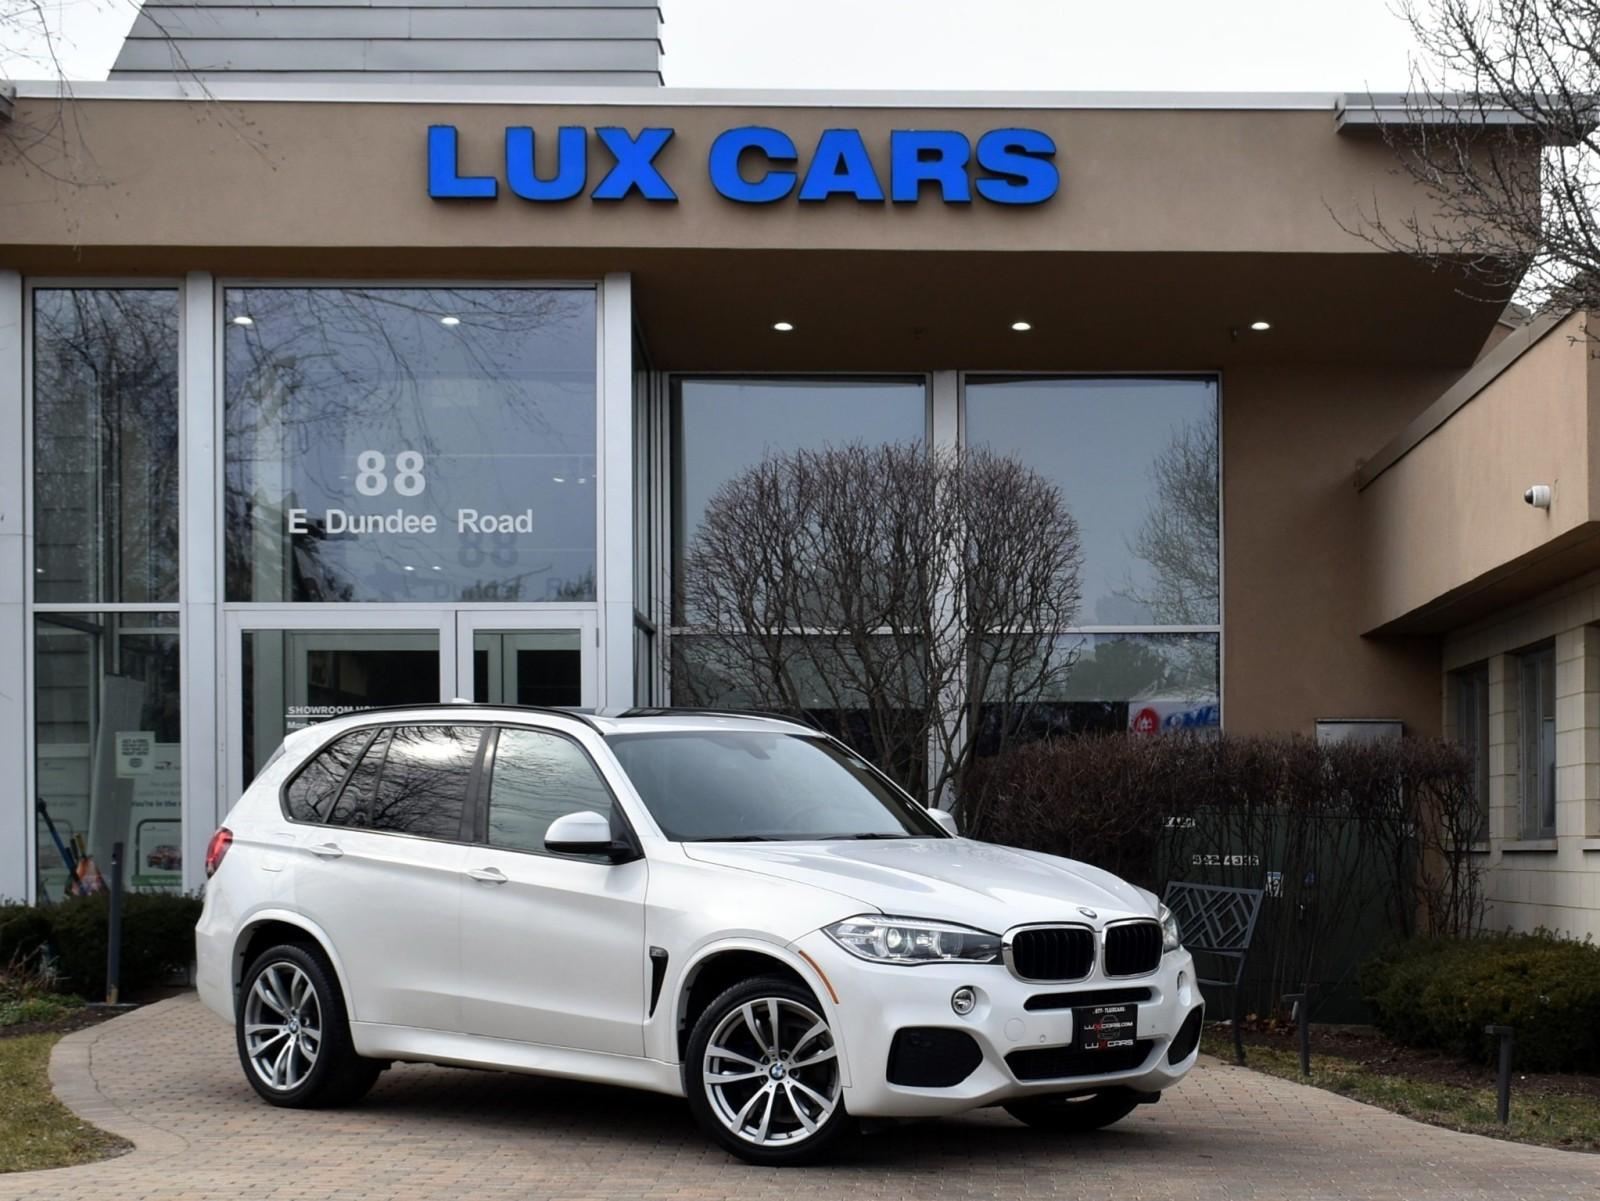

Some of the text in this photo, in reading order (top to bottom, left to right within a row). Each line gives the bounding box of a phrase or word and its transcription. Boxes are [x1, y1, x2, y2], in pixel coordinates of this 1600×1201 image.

[427, 124, 1060, 204] LUX CARS
[355, 450, 426, 496] 88
[287, 508, 533, 534] E Dundee Road
